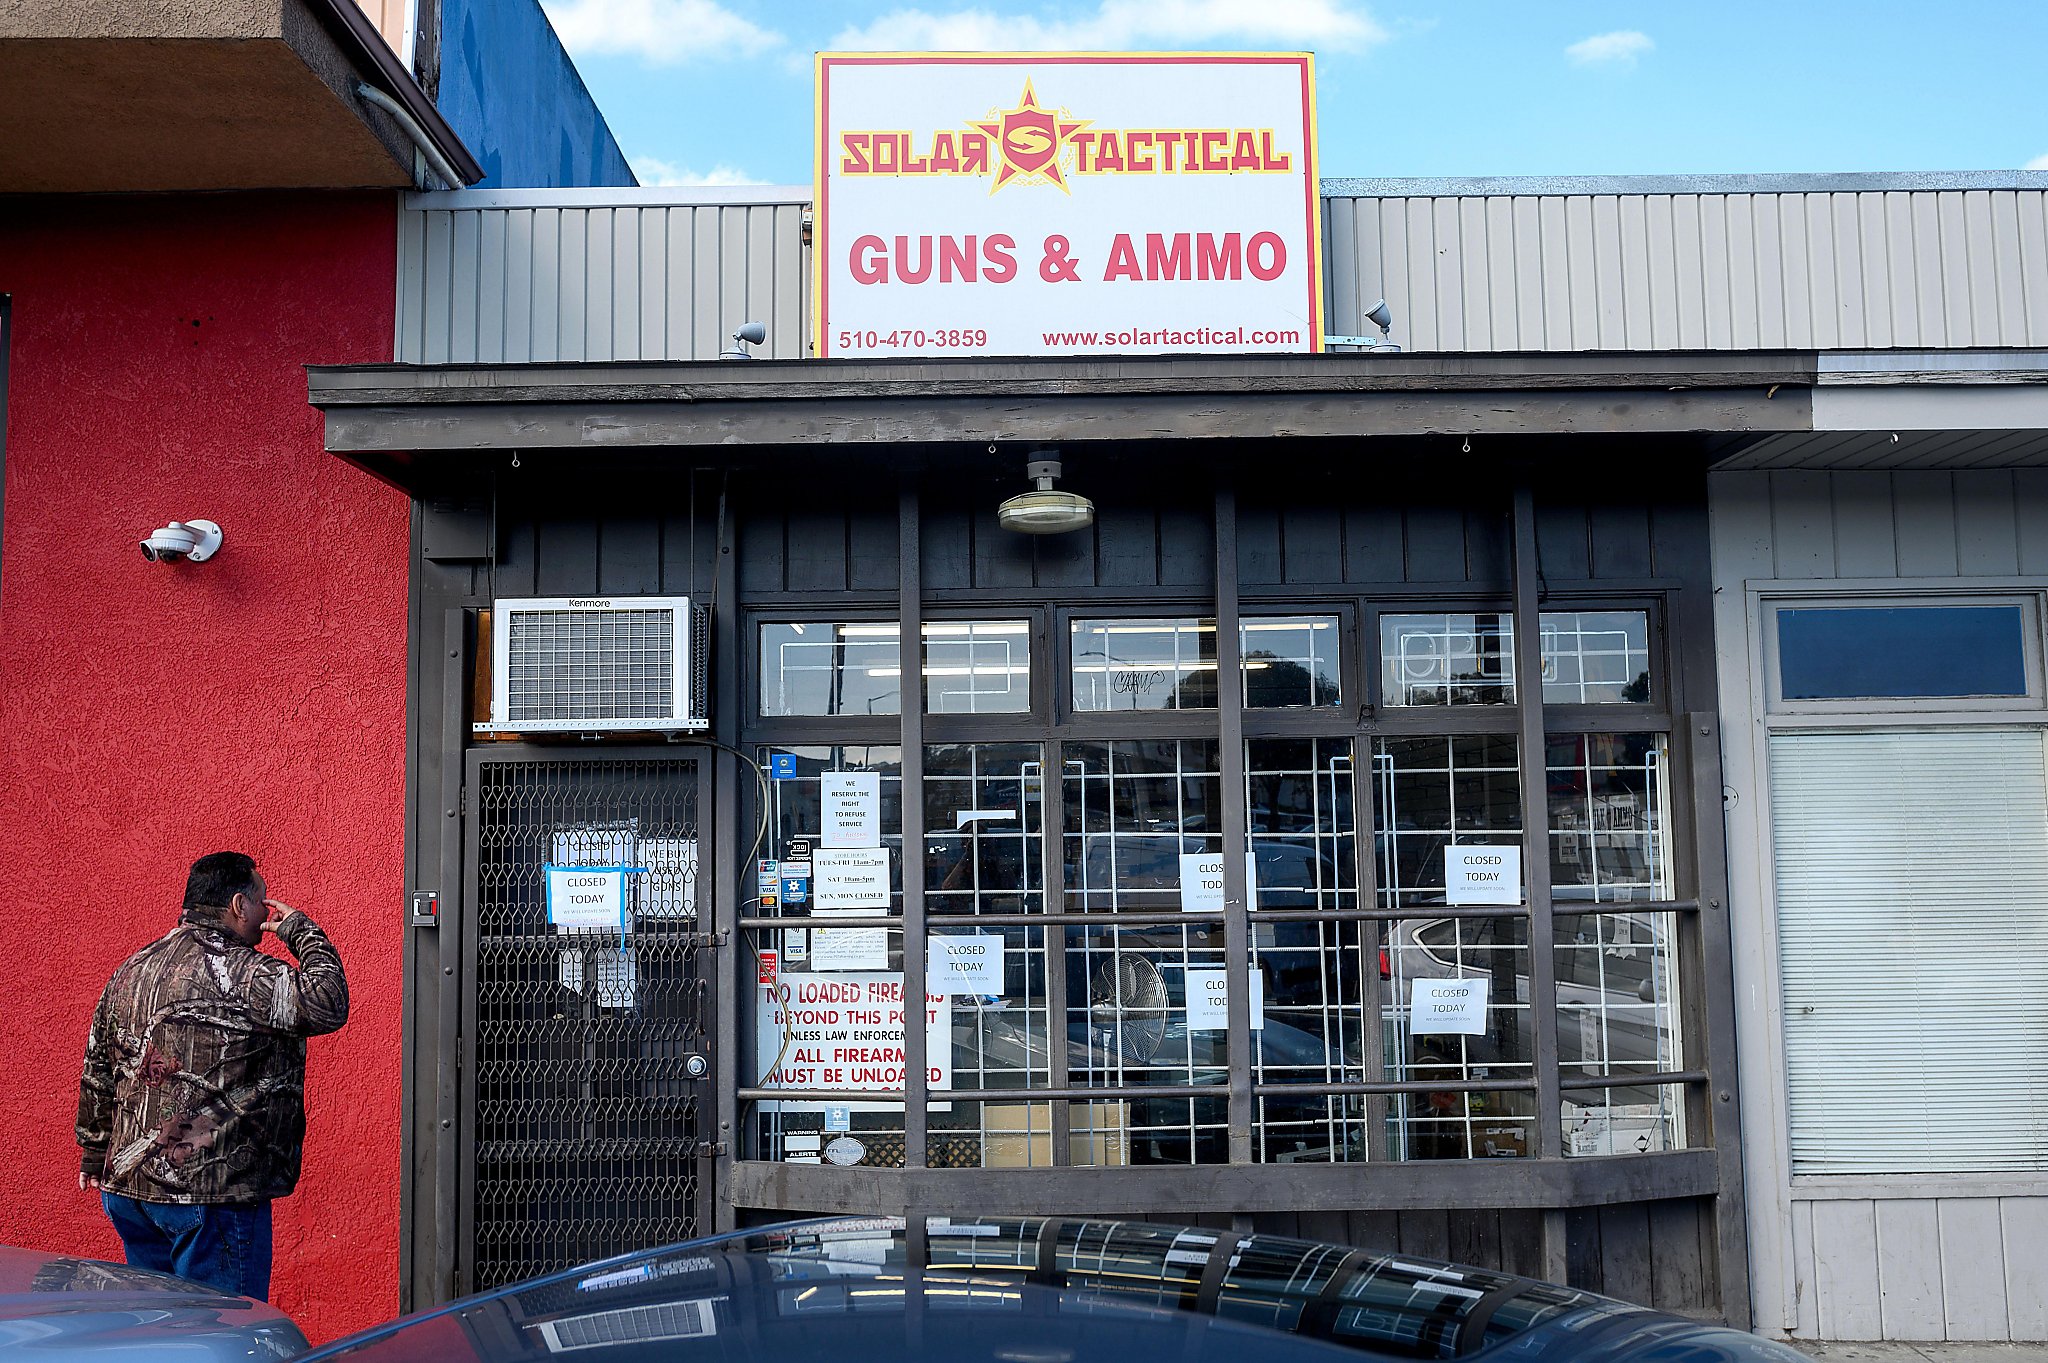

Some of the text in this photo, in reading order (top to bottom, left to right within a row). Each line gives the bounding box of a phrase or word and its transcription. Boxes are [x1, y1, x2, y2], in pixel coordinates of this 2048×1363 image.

[1069, 129, 1293, 174] TACTICAL
[848, 230, 1288, 285] GUNS & AMMO
[838, 326, 1301, 350] 510-470-3859 www.solartactical.com
[568, 599, 611, 608] Kenmore
[572, 840, 611, 851] CLOSED
[648, 849, 688, 859] WE BUY
[1463, 855, 1502, 865] CLOSED
[654, 866, 681, 875] USED
[1199, 863, 1224, 873] CLOS
[843, 875, 875, 884] 10am-5pm
[1465, 872, 1500, 881] TODAY
[567, 877, 607, 888] CLOSED
[652, 883, 681, 892] GUNS
[1201, 880, 1223, 889] TOD
[569, 894, 605, 904] TODAY
[854, 892, 884, 900] CLOSED
[947, 945, 986, 955] CLOSED
[949, 962, 984, 972] TODAY
[1205, 980, 1225, 990] CLO
[766, 983, 944, 1004] NO LOADED FIREA
[1431, 988, 1469, 998] CLOSED
[1207, 997, 1227, 1006] TOD
[1432, 1003, 1466, 1013] TODAY
[774, 1010, 840, 1025] BEYOND
[847, 1010, 881, 1024] THIS
[825, 1031, 848, 1041] LAW
[793, 1047, 906, 1063] ALL FIREARM
[769, 1067, 942, 1084] MUST BE UNLOAD
